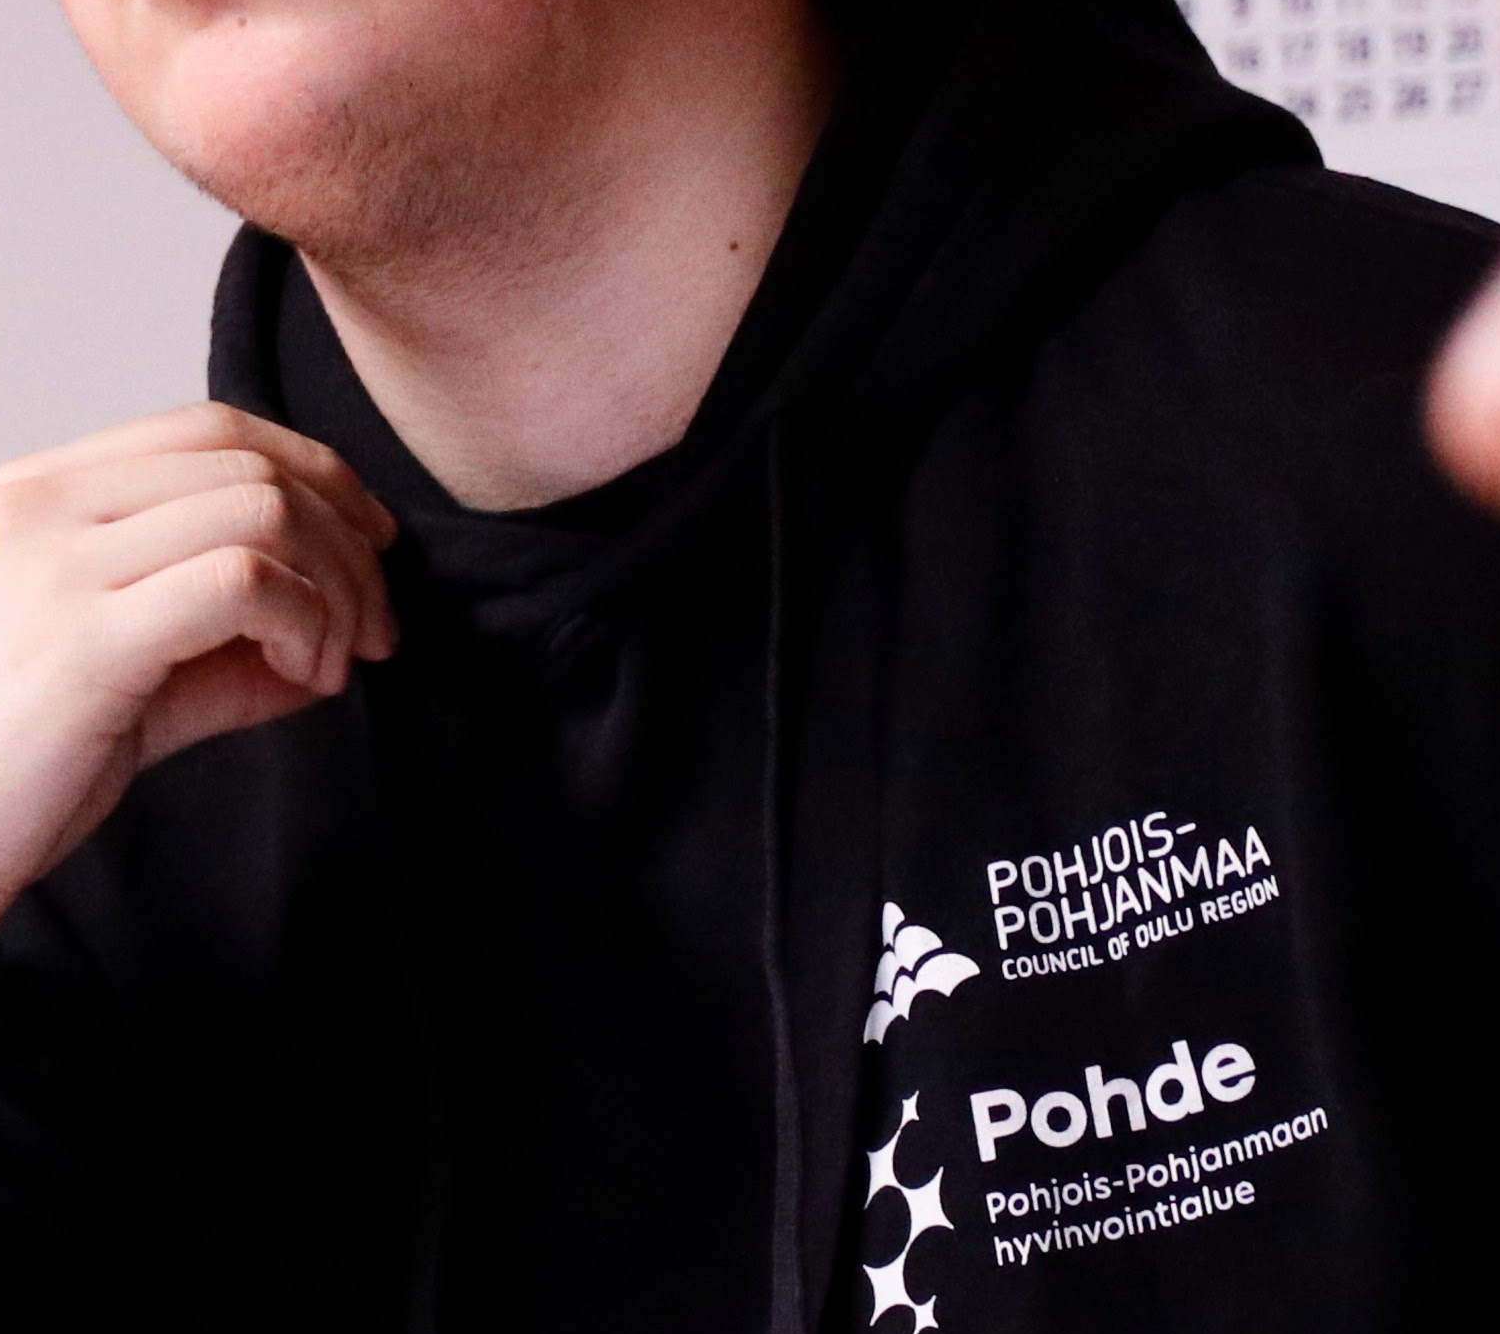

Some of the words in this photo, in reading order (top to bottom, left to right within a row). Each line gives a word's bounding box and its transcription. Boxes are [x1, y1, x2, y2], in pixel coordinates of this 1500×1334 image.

[987, 811, 1197, 905] POHJOIS-
[994, 826, 1271, 951] POHJANMAA
[1002, 945, 1104, 981] COUNCIL
[1107, 932, 1131, 961] OF
[1135, 907, 1194, 948] OULU
[1200, 875, 1280, 924] REGION
[970, 1039, 1256, 1163] Pohde
[986, 1106, 1329, 1223] Pohjois-Pohjanmaan
[994, 1178, 1256, 1266] hyvinvointialue
